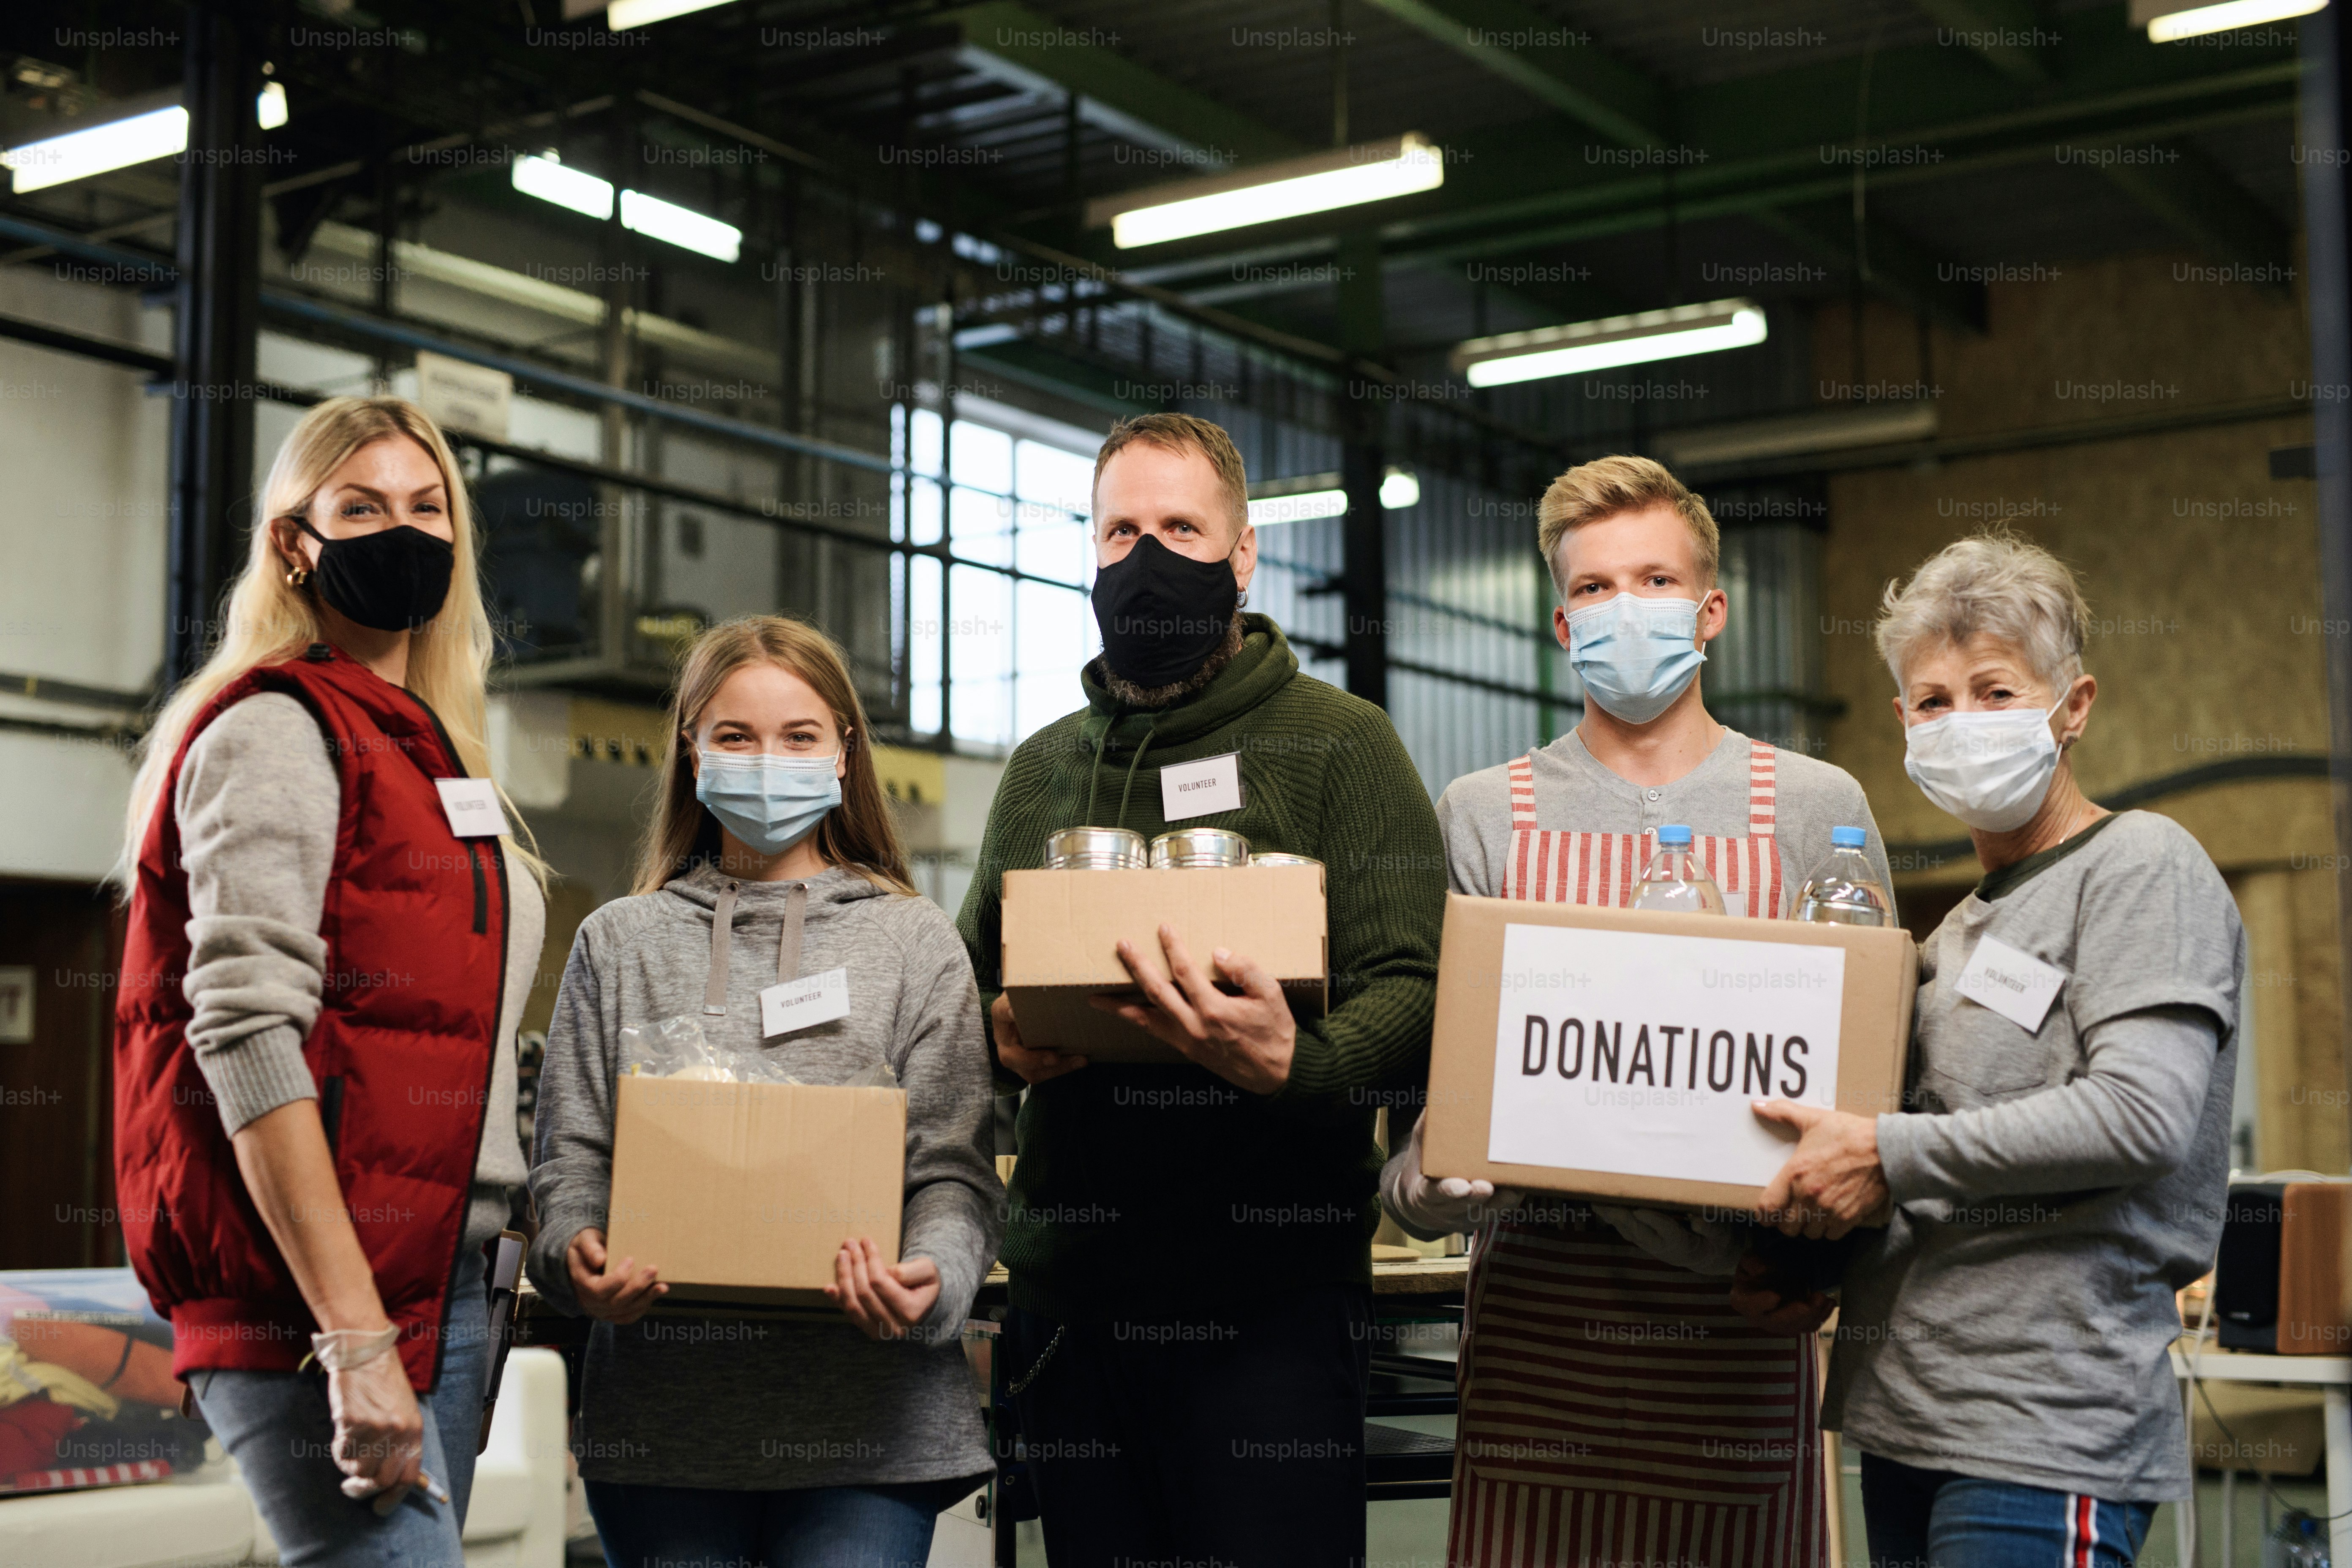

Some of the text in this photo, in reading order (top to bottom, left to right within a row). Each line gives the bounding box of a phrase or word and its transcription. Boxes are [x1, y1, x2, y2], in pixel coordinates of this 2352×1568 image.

[1178, 778, 1217, 792] VOLUNTEER
[1984, 966, 2026, 994] VOLUNTEER
[781, 991, 822, 1008] VOLUNTEER
[1522, 1015, 1809, 1099] DONATIONS
